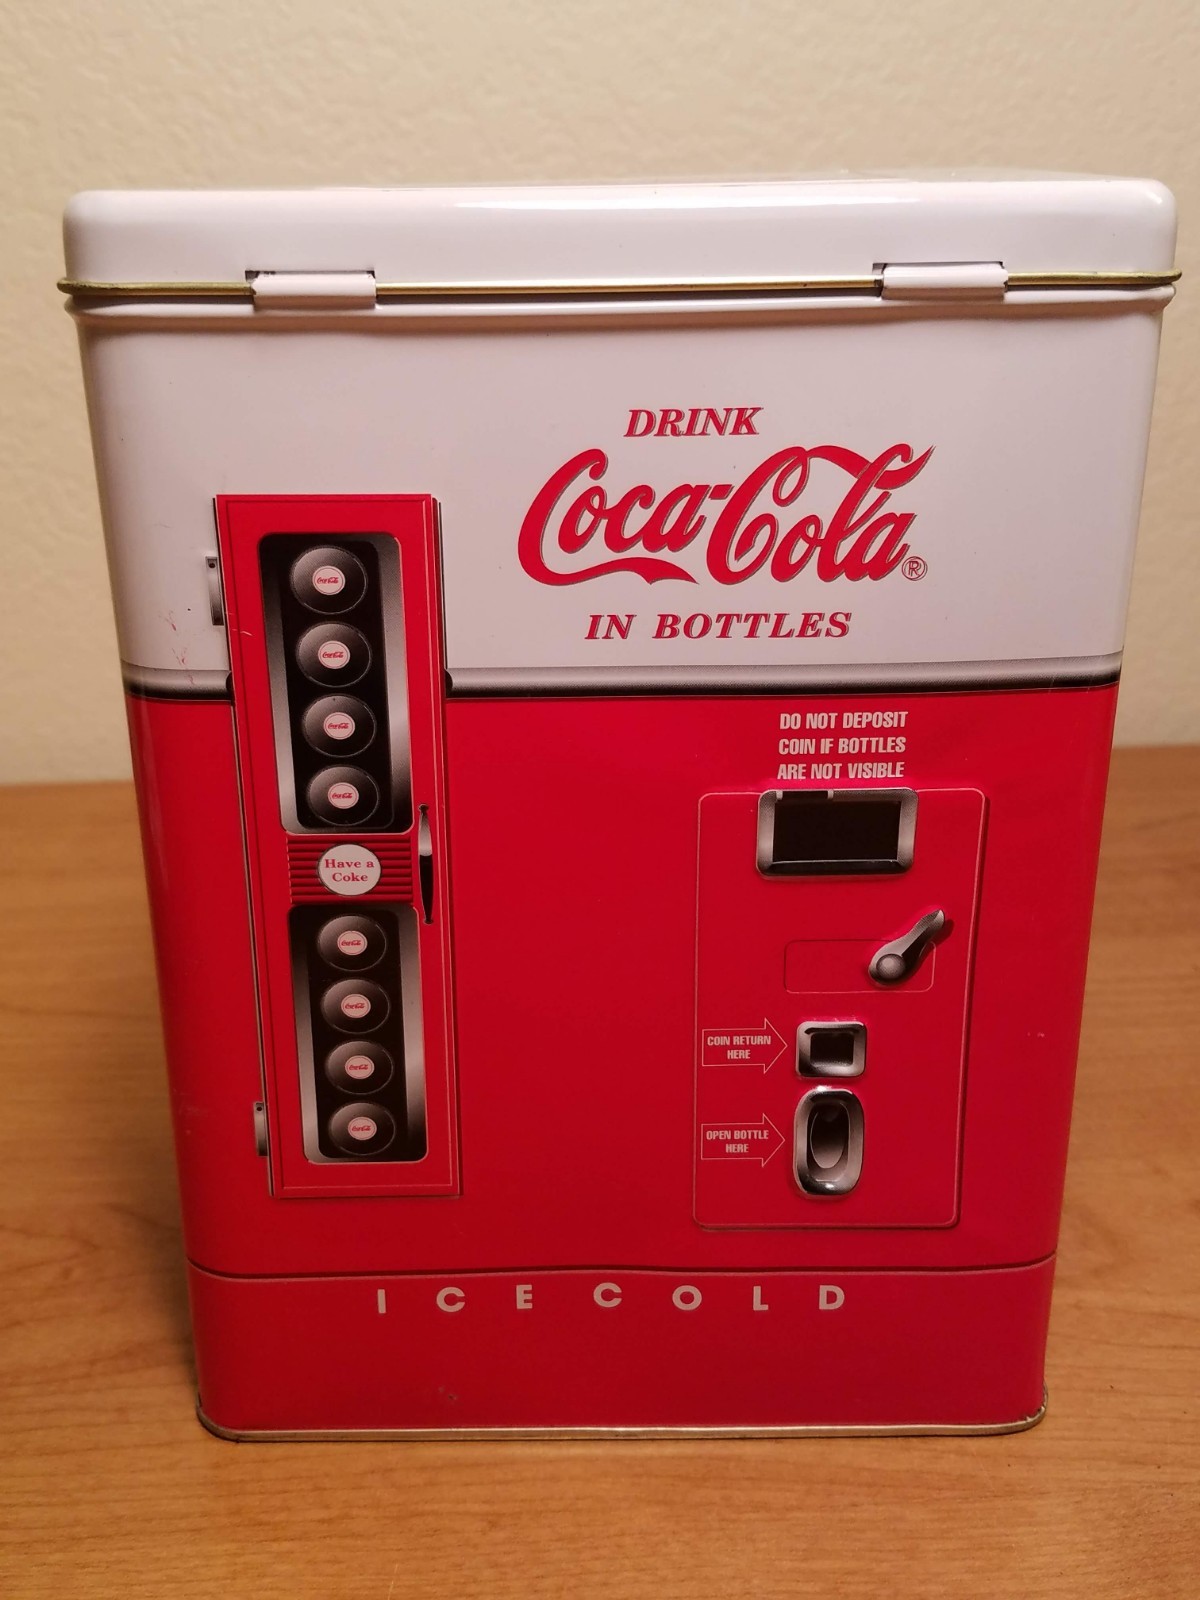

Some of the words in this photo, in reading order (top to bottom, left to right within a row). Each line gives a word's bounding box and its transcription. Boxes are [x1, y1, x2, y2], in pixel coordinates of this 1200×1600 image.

[624, 407, 763, 437] DRINK
[518, 443, 937, 586] Coca-Cola
[585, 614, 637, 640] IN
[652, 611, 852, 639] BOTTLES
[780, 713, 801, 730] DO
[805, 712, 838, 729] NOT
[842, 711, 908, 729] DEPOSIT
[778, 738, 815, 755] COIN
[820, 738, 834, 754] IF
[838, 736, 907, 754] BOTTLES
[776, 763, 806, 780] ARE
[810, 763, 843, 779] NOT
[847, 761, 905, 778] VISIBLE
[324, 858, 361, 868] Have
[332, 872, 368, 882] Coke
[707, 1036, 730, 1046] COIN
[733, 1035, 771, 1045] RETURN
[727, 1050, 751, 1060] HERE
[706, 1130, 731, 1140] OPEN
[734, 1130, 769, 1140] BOTTLE
[725, 1144, 749, 1153] HERE
